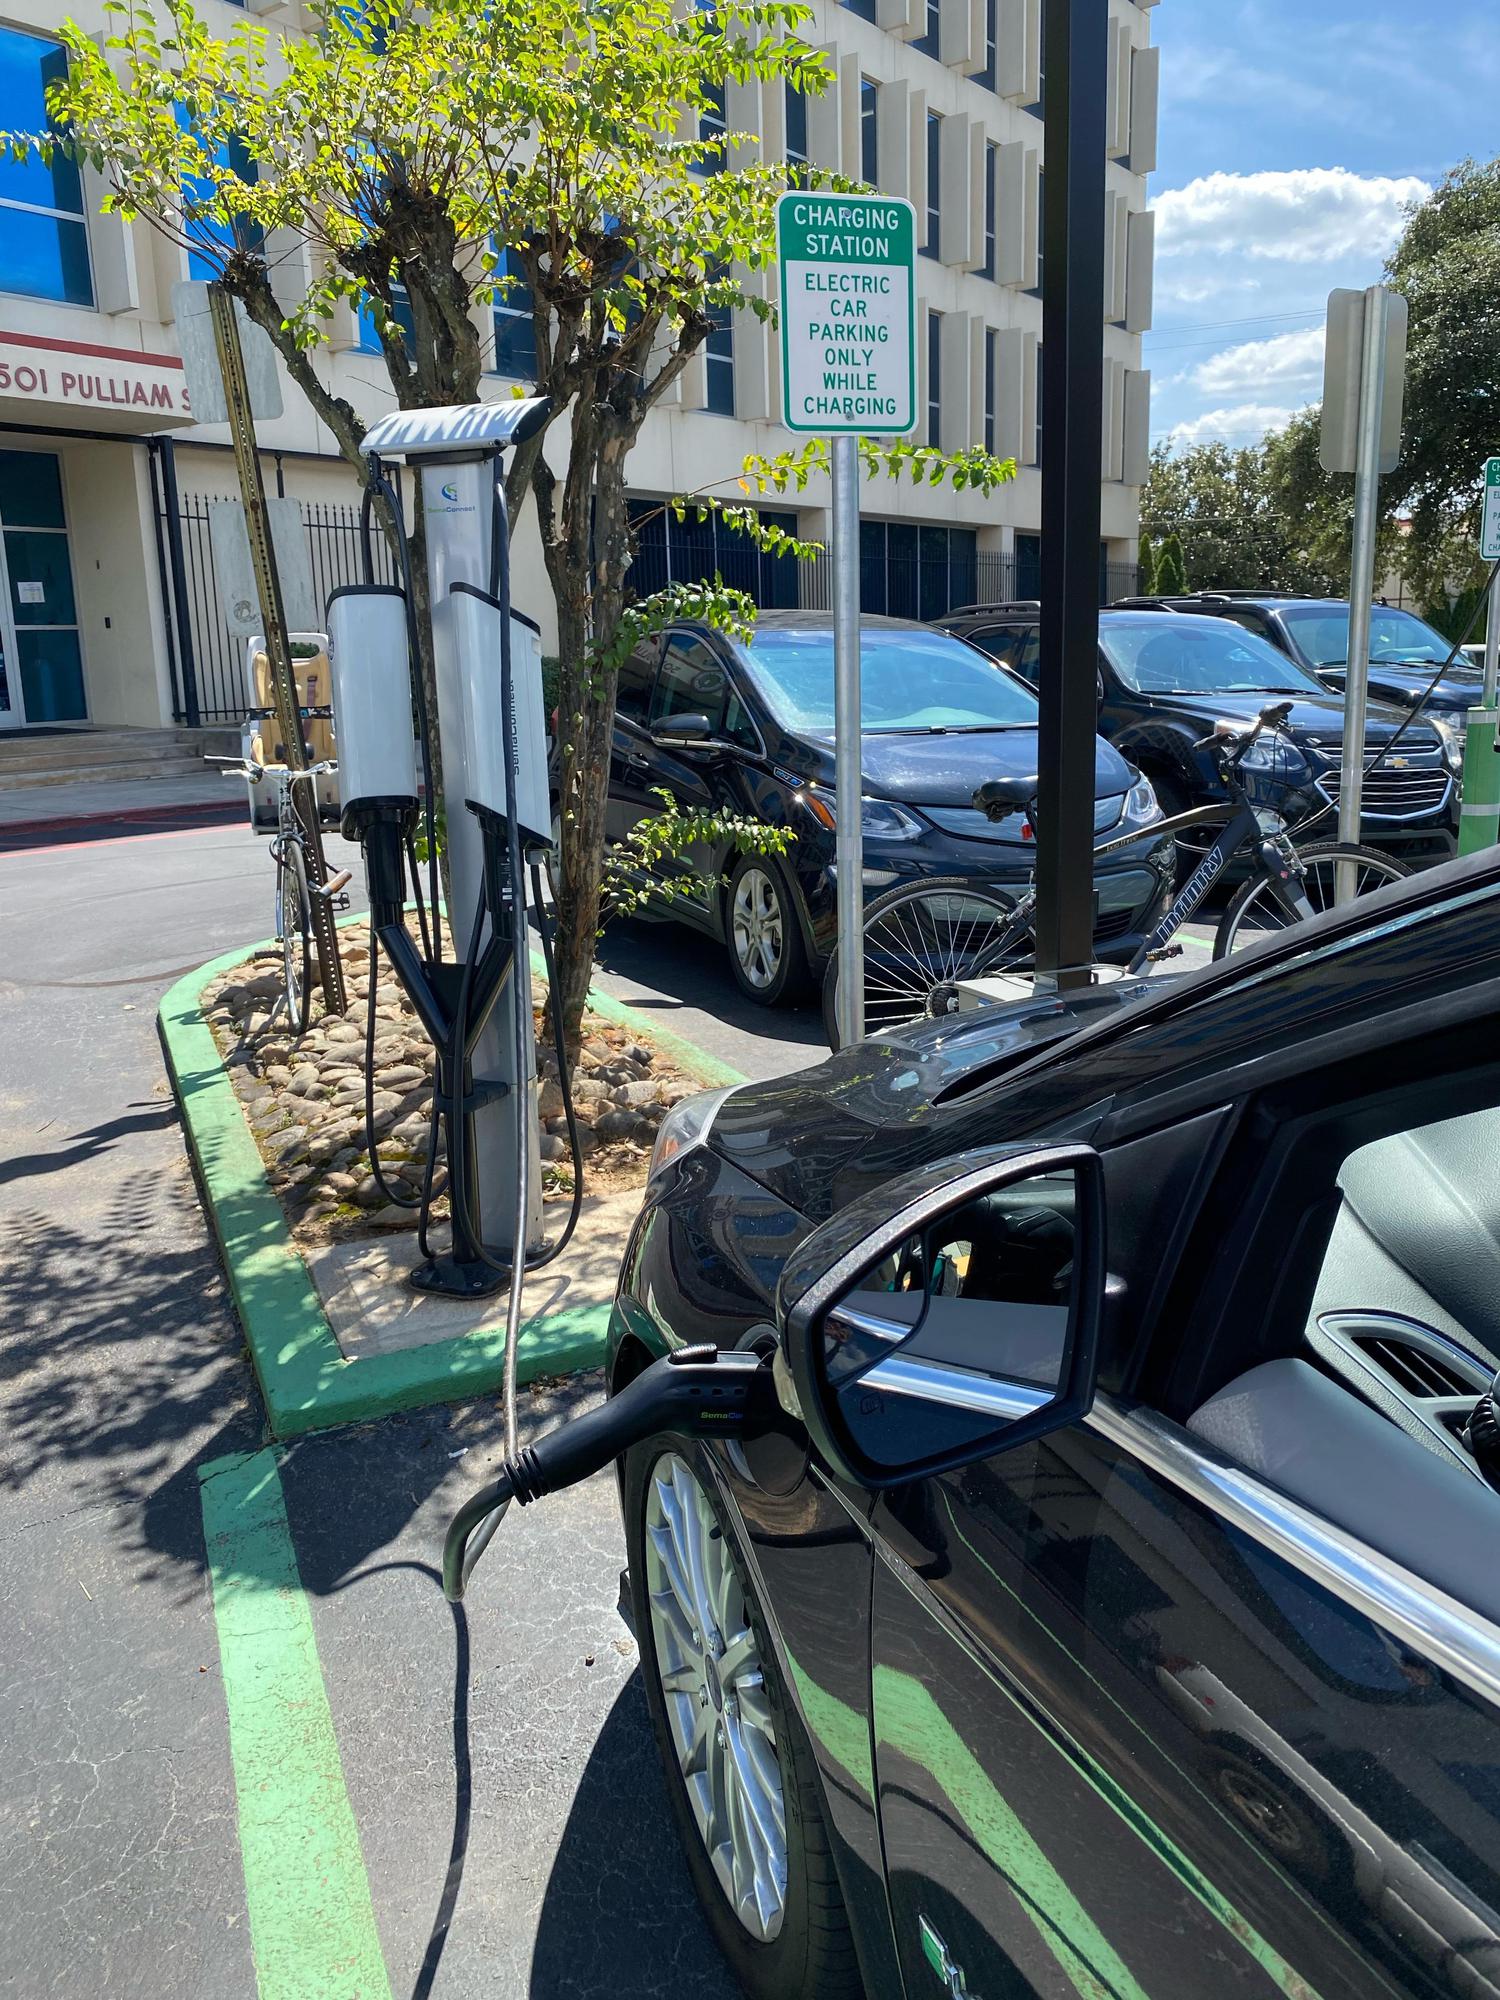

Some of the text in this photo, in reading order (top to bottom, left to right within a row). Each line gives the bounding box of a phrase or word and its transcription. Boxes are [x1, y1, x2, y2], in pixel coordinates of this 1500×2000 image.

[793, 204, 899, 231] CHARGING
[805, 234, 889, 258] STATION
[805, 272, 891, 294] ELECTRIC
[830, 299, 867, 318] CAR
[809, 323, 889, 342] PARKING
[824, 348, 874, 366] ONLY
[0, 363, 48, 394] 501
[61, 372, 174, 409] PULLIAM
[823, 372, 877, 391] WHILE
[804, 396, 897, 416] CHARGING
